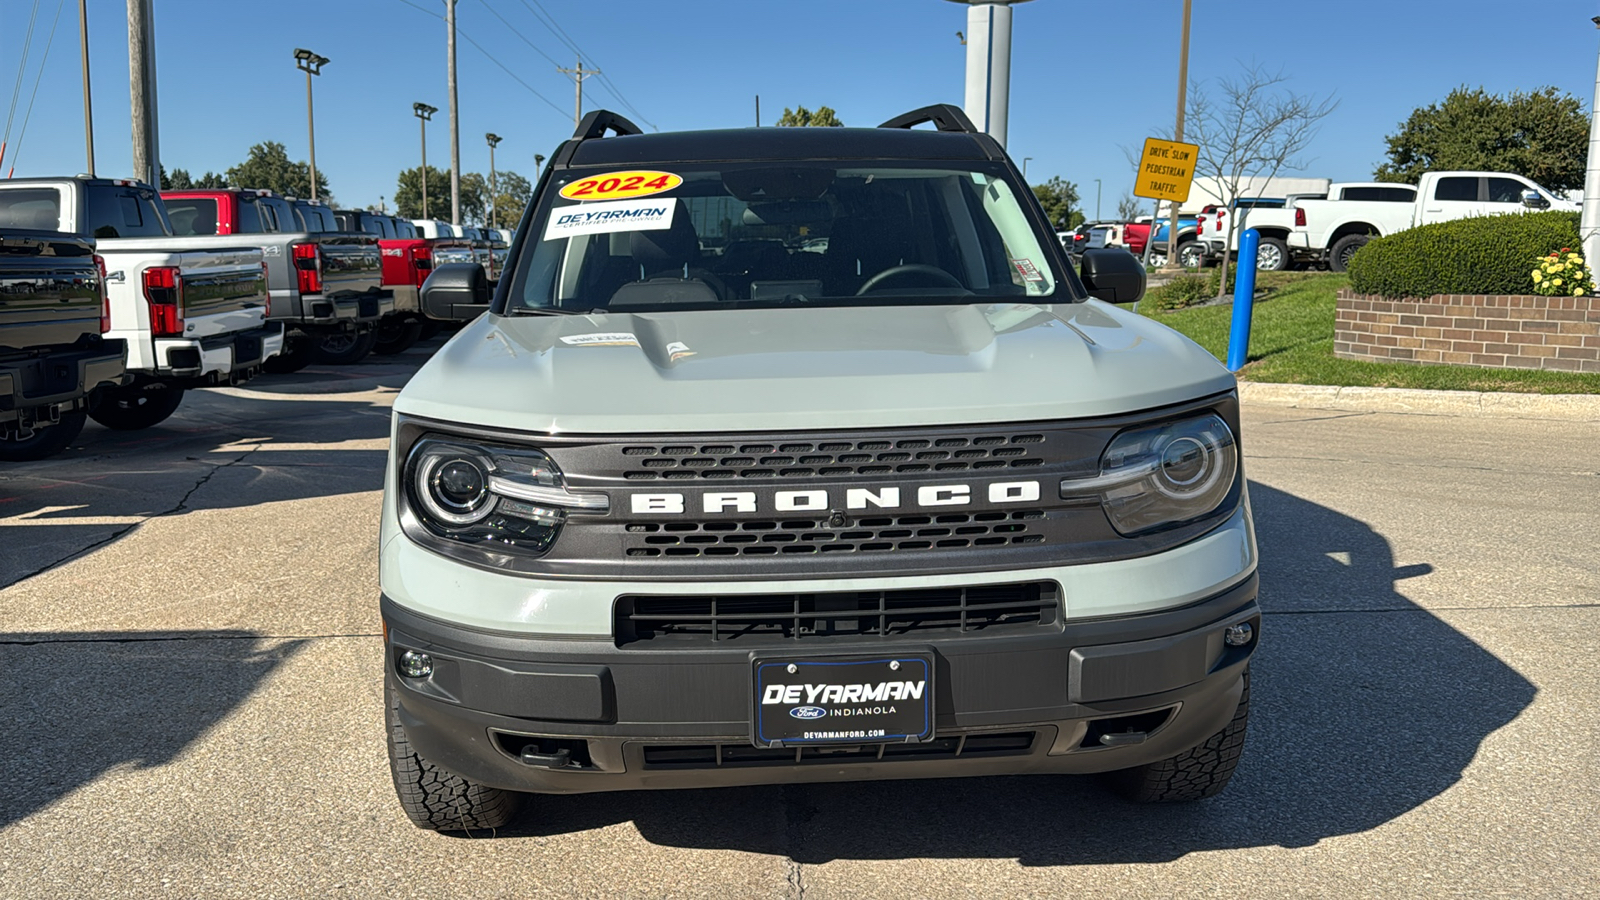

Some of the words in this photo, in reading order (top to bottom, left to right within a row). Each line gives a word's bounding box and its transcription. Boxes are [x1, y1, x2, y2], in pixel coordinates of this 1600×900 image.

[1149, 147, 1169, 158] DRIVE
[1172, 150, 1190, 161] SLOW
[1145, 163, 1186, 177] PEDESTRIAN
[570, 174, 671, 197] 2024
[1149, 181, 1177, 193] TRAFFIC
[557, 207, 667, 225] DEYARMAN
[563, 219, 608, 229] CERTIFIED
[631, 480, 1040, 514] BRONCO
[762, 680, 926, 705] DEYARMAN
[830, 706, 897, 717] INDIANOLA
[804, 729, 885, 739] DEYARMANFORD.COM
